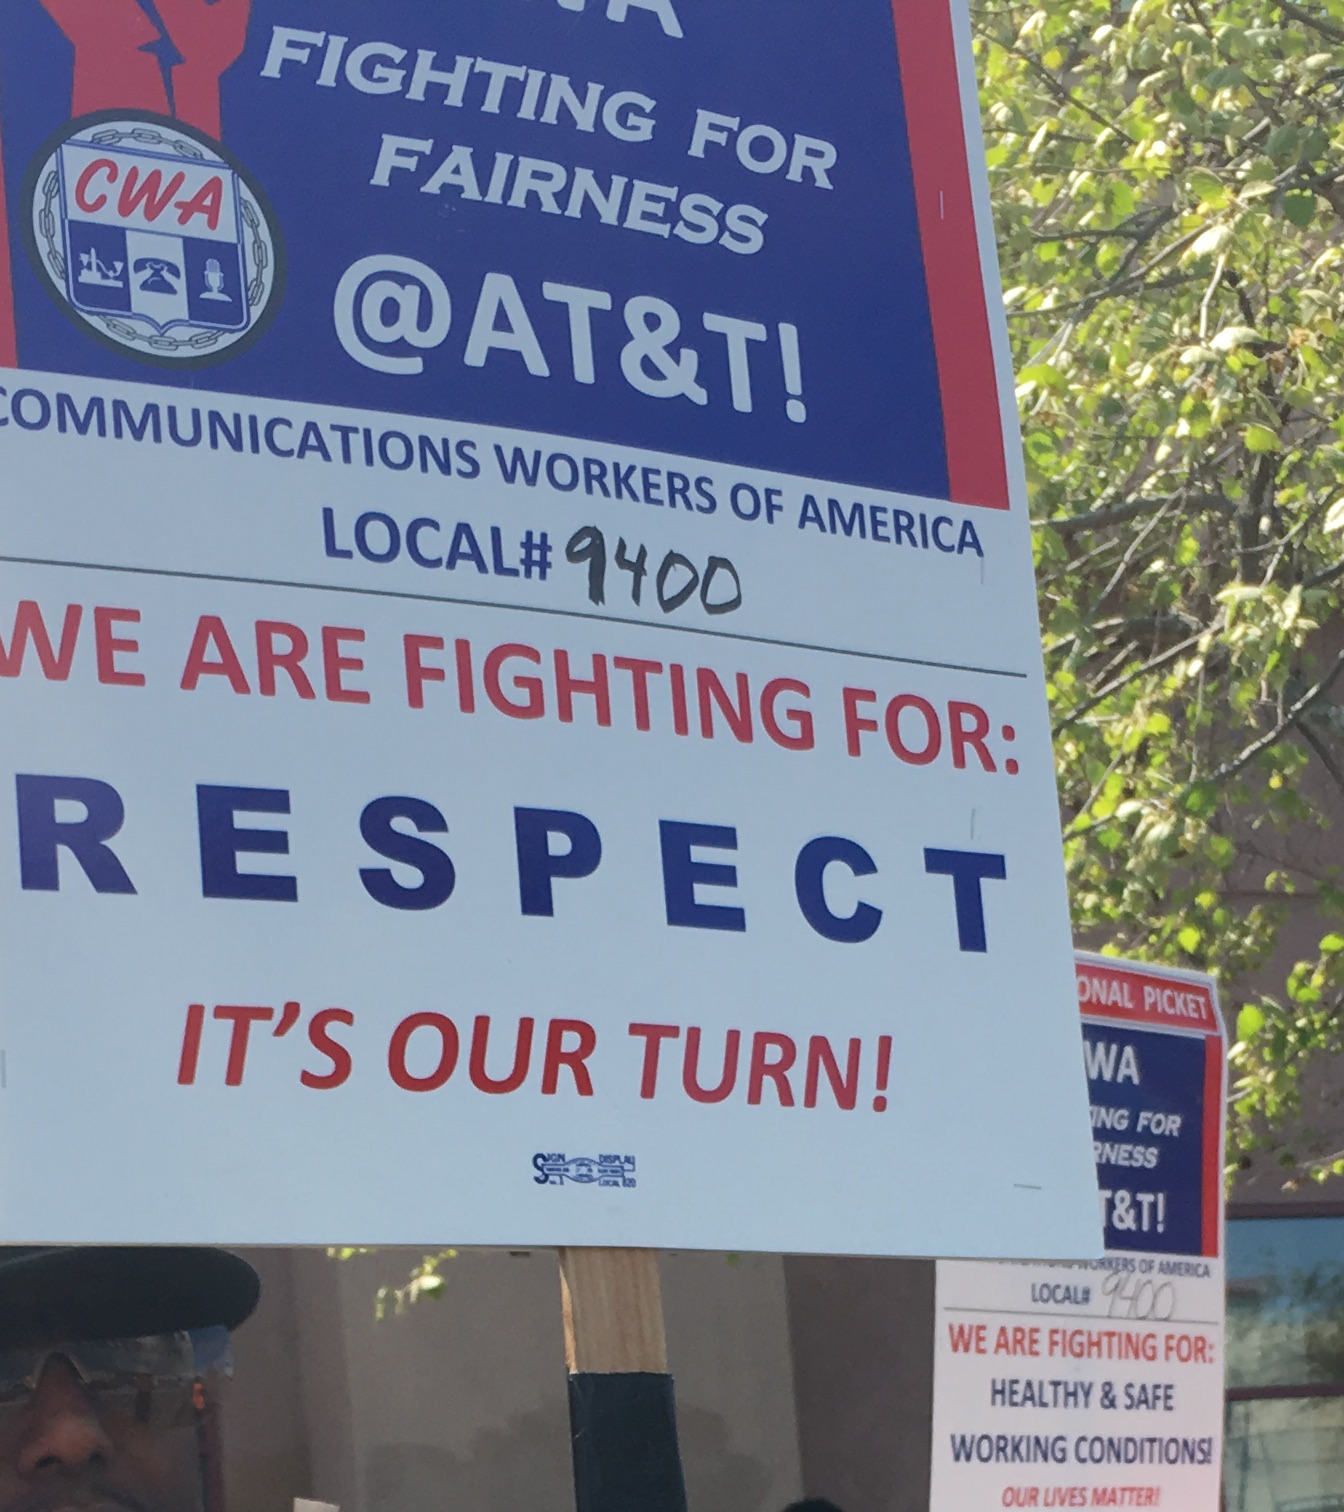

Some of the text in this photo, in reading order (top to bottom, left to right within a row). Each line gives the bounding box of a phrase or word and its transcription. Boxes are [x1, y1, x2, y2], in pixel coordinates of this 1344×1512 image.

[260, 26, 838, 190] FIGHTING FOR
[72, 156, 224, 231] CWA
[370, 133, 768, 255] FAIRNESS
[332, 254, 808, 424] @AT&T!
[494, 445, 717, 516] WORKERS
[730, 479, 785, 525] OF
[797, 492, 984, 560] AMERICA
[564, 526, 742, 616] 9400
[180, 614, 371, 706] ARE
[403, 632, 814, 751] FIGHTING
[843, 687, 1020, 775] FOR:
[15, 773, 1006, 953] RESPECT
[1143, 985, 1208, 1019] PICKET
[176, 1001, 893, 1112] IT'S OUR TURN!
[1136, 1111, 1182, 1137] FOR
[1101, 1270, 1176, 1320] 9400
[1139, 1258, 1156, 1274] OF
[1157, 1260, 1211, 1278] AMERICA
[948, 1322, 1215, 1364] WE ARE FIGHTING FOR:
[990, 1378, 1175, 1411] HEALTHY & SAFE
[950, 1433, 1213, 1465] WORKING CONDITIONS!
[1001, 1486, 1161, 1508] OUR LIVES MATTER!
